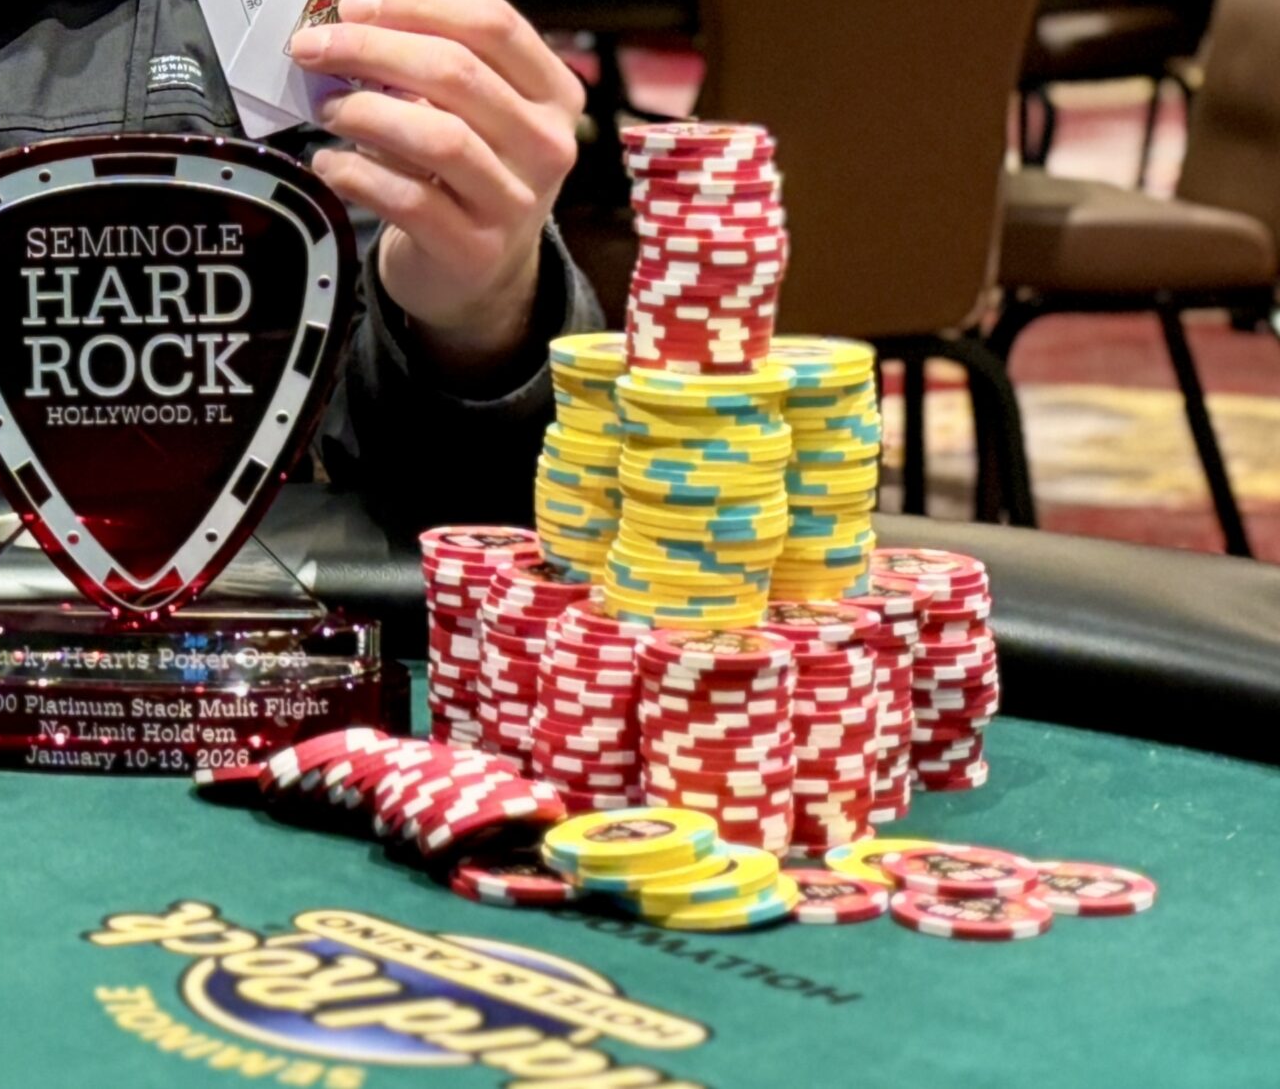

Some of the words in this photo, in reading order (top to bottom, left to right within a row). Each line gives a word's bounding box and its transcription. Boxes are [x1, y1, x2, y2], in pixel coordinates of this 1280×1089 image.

[26, 223, 244, 259] SEMINOLE
[20, 264, 253, 326] HARD
[23, 333, 254, 397] ROCK
[46, 405, 198, 426] HOLLYWOOD,
[205, 404, 234, 423] FL
[61, 645, 150, 670] Hearts
[157, 647, 231, 670] Poker
[239, 647, 310, 672] Open
[24, 694, 125, 716] Platinum
[131, 697, 192, 718] Stack
[199, 697, 259, 718] Mulit
[265, 697, 330, 718] Flight
[39, 720, 71, 741] No
[78, 721, 136, 742] Limit
[143, 722, 237, 743] Hold'em
[25, 748, 117, 771] January
[123, 748, 190, 771] 10-13,
[196, 747, 250, 770] 2026
[82, 899, 404, 1011] Rock
[316, 915, 485, 973] CASINO
[530, 983, 685, 1041] HOTEL
[94, 985, 366, 1089] SEMINOLE
